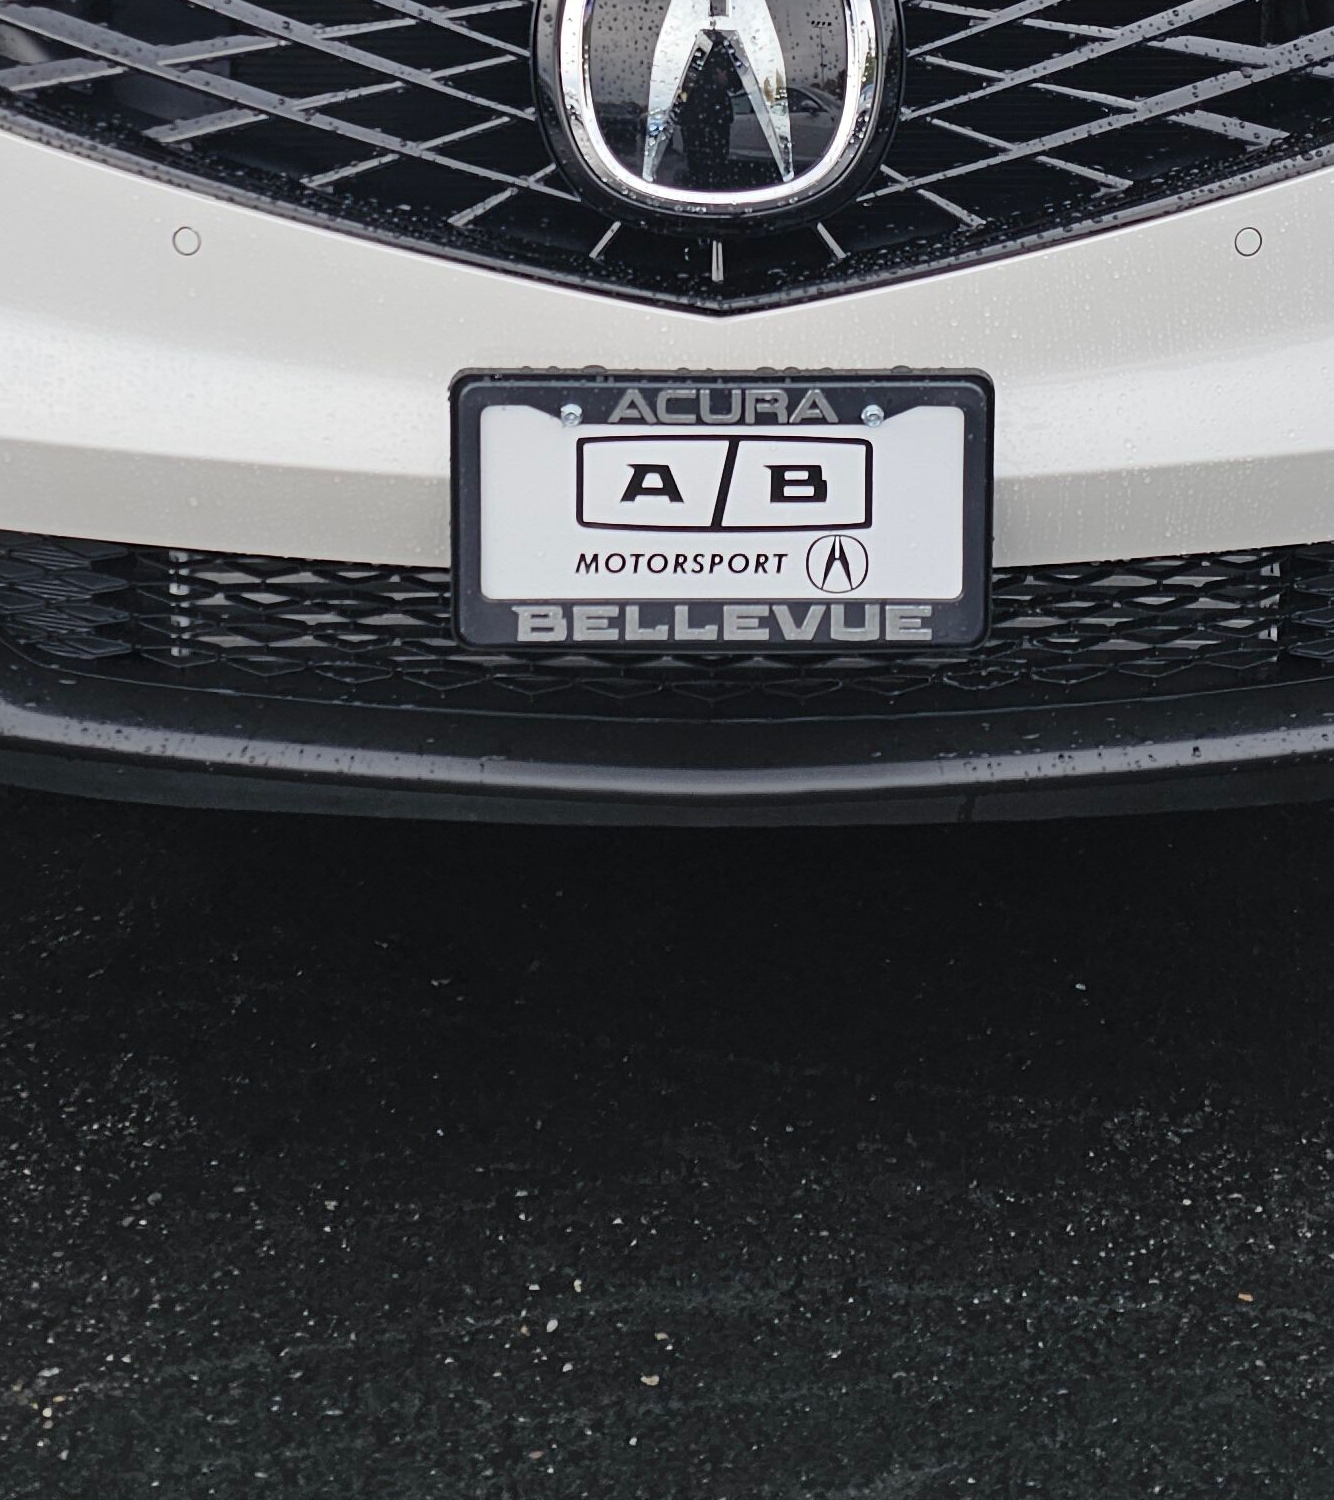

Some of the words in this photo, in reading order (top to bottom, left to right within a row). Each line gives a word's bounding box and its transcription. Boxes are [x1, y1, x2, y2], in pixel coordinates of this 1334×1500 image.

[606, 388, 839, 425] ACURA
[575, 552, 789, 575] MOTORSPORT
[511, 604, 933, 643] BELLEVUE
